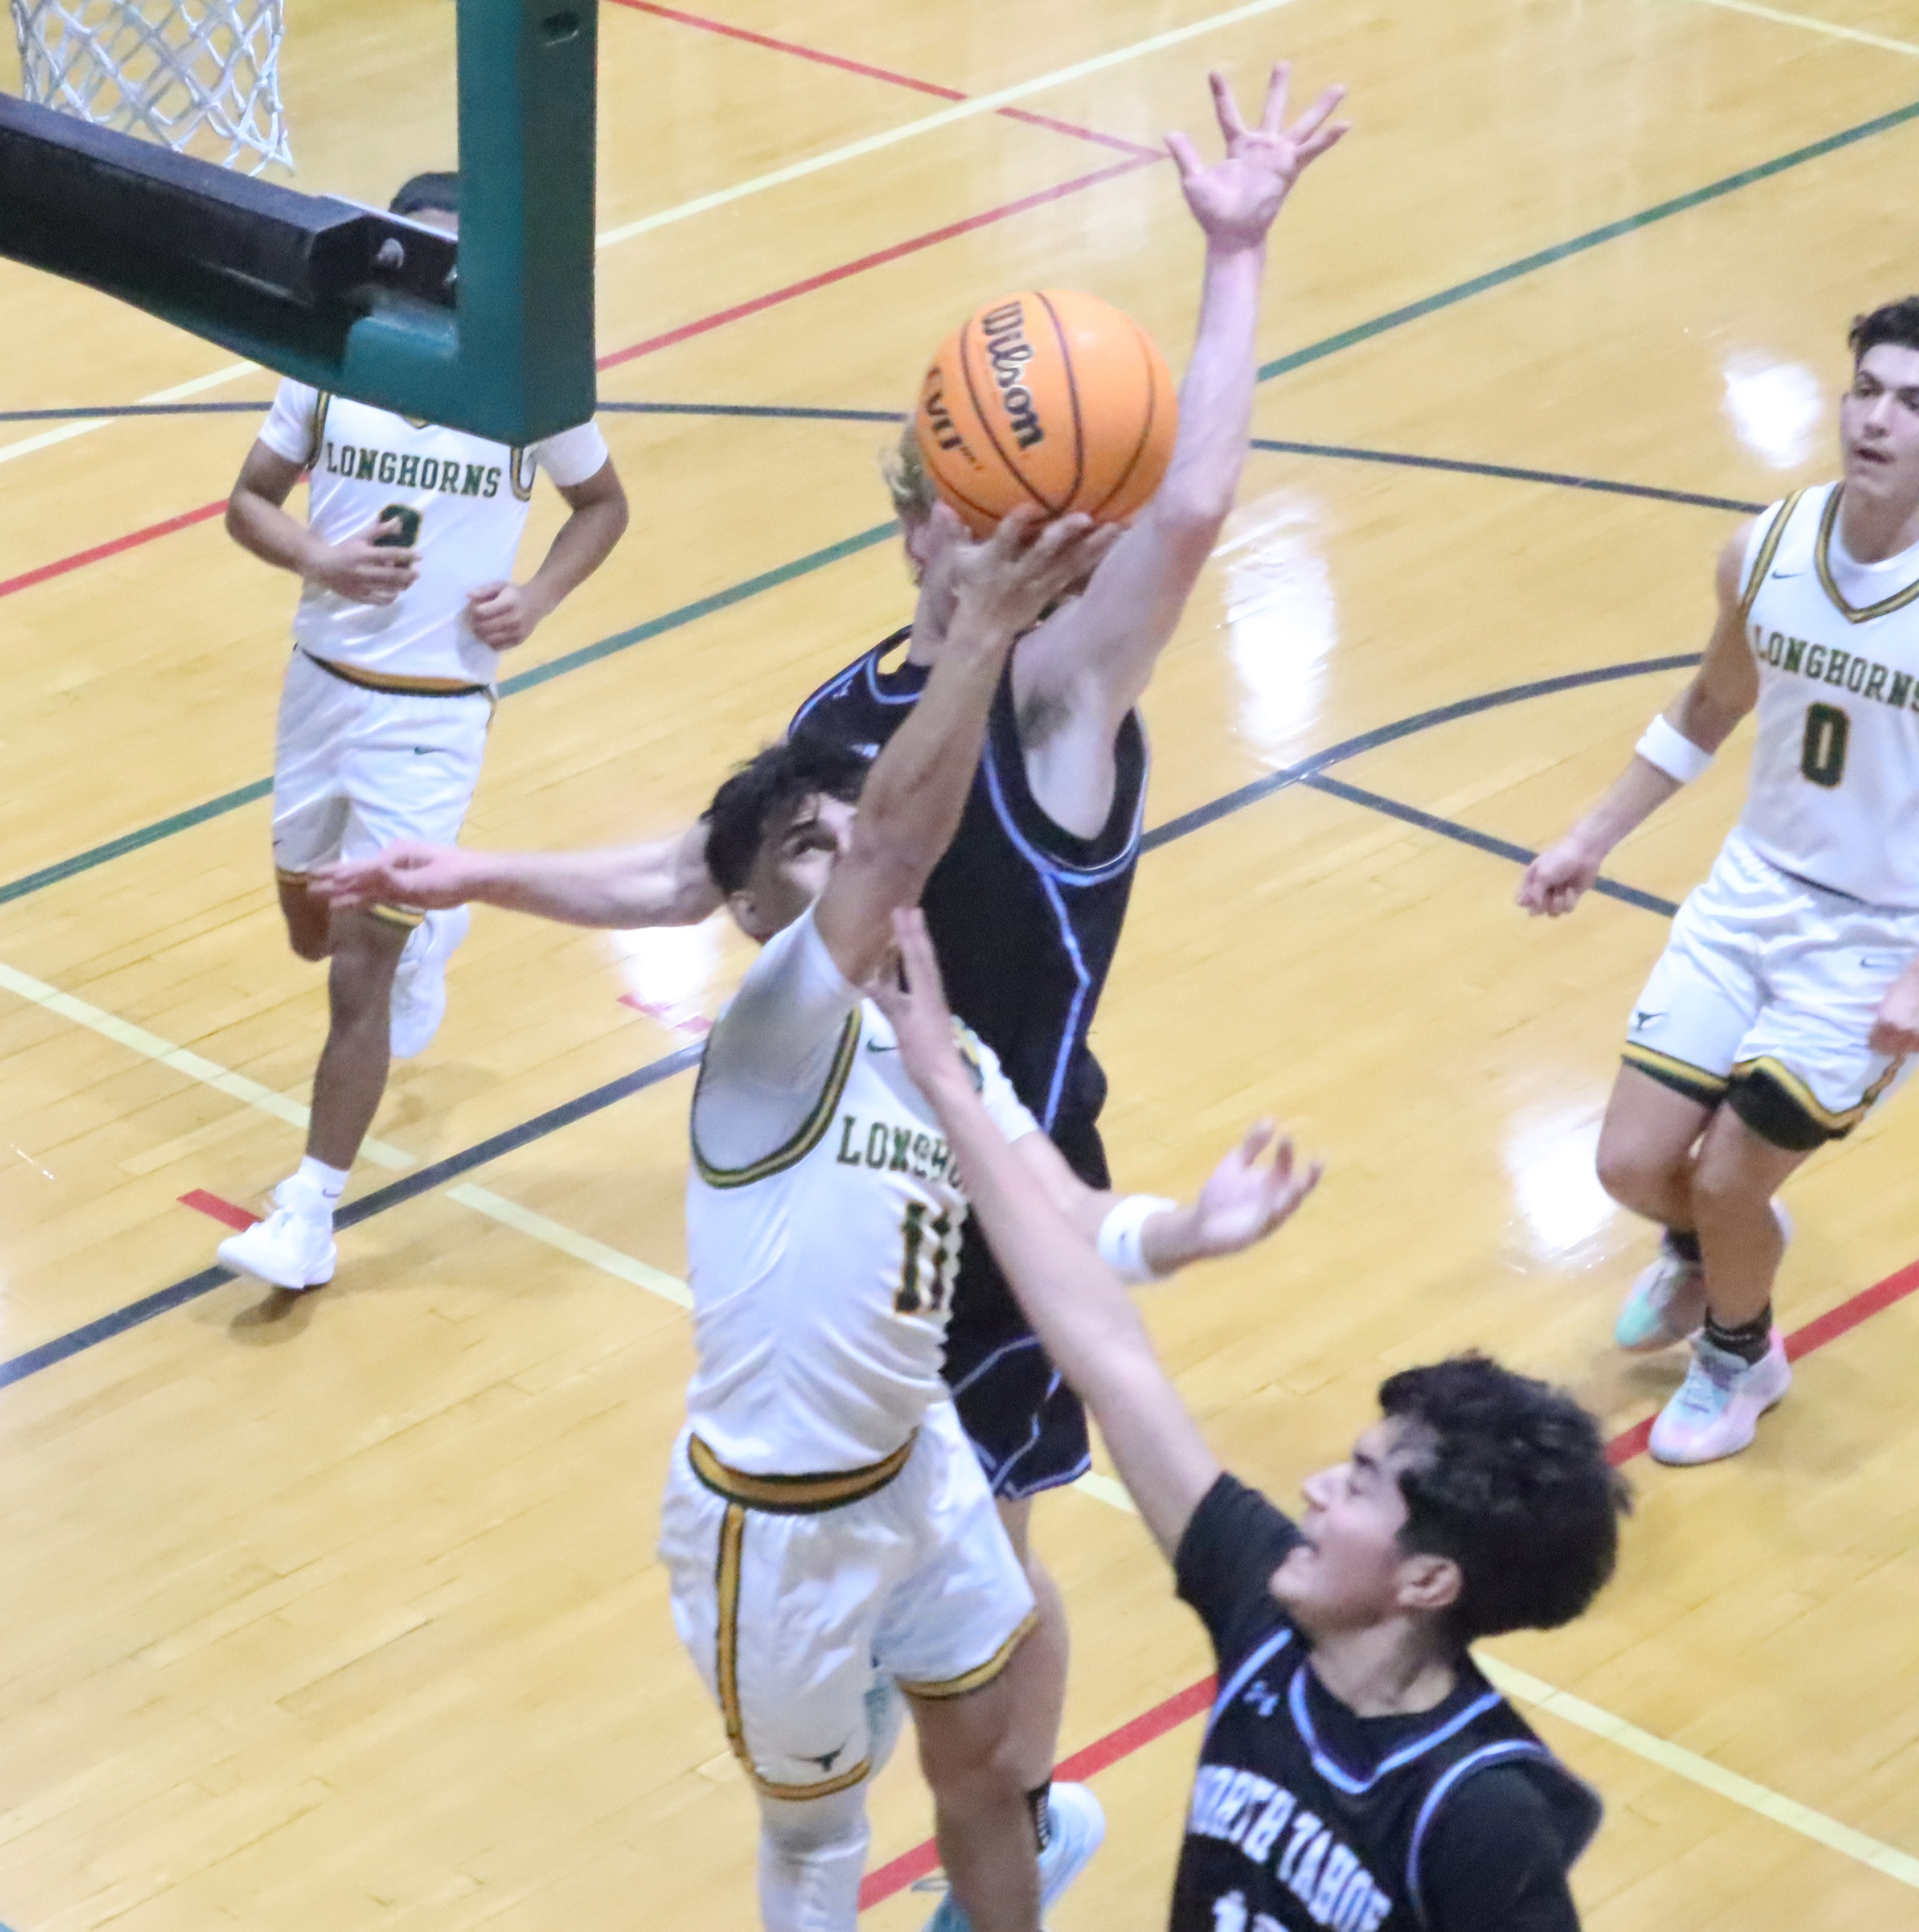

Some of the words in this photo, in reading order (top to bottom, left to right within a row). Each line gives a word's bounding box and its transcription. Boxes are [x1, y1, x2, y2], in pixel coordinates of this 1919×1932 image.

[982, 300, 1044, 450] Wilson
[326, 441, 502, 498] LONGHORNS
[1801, 700, 1850, 791] 0
